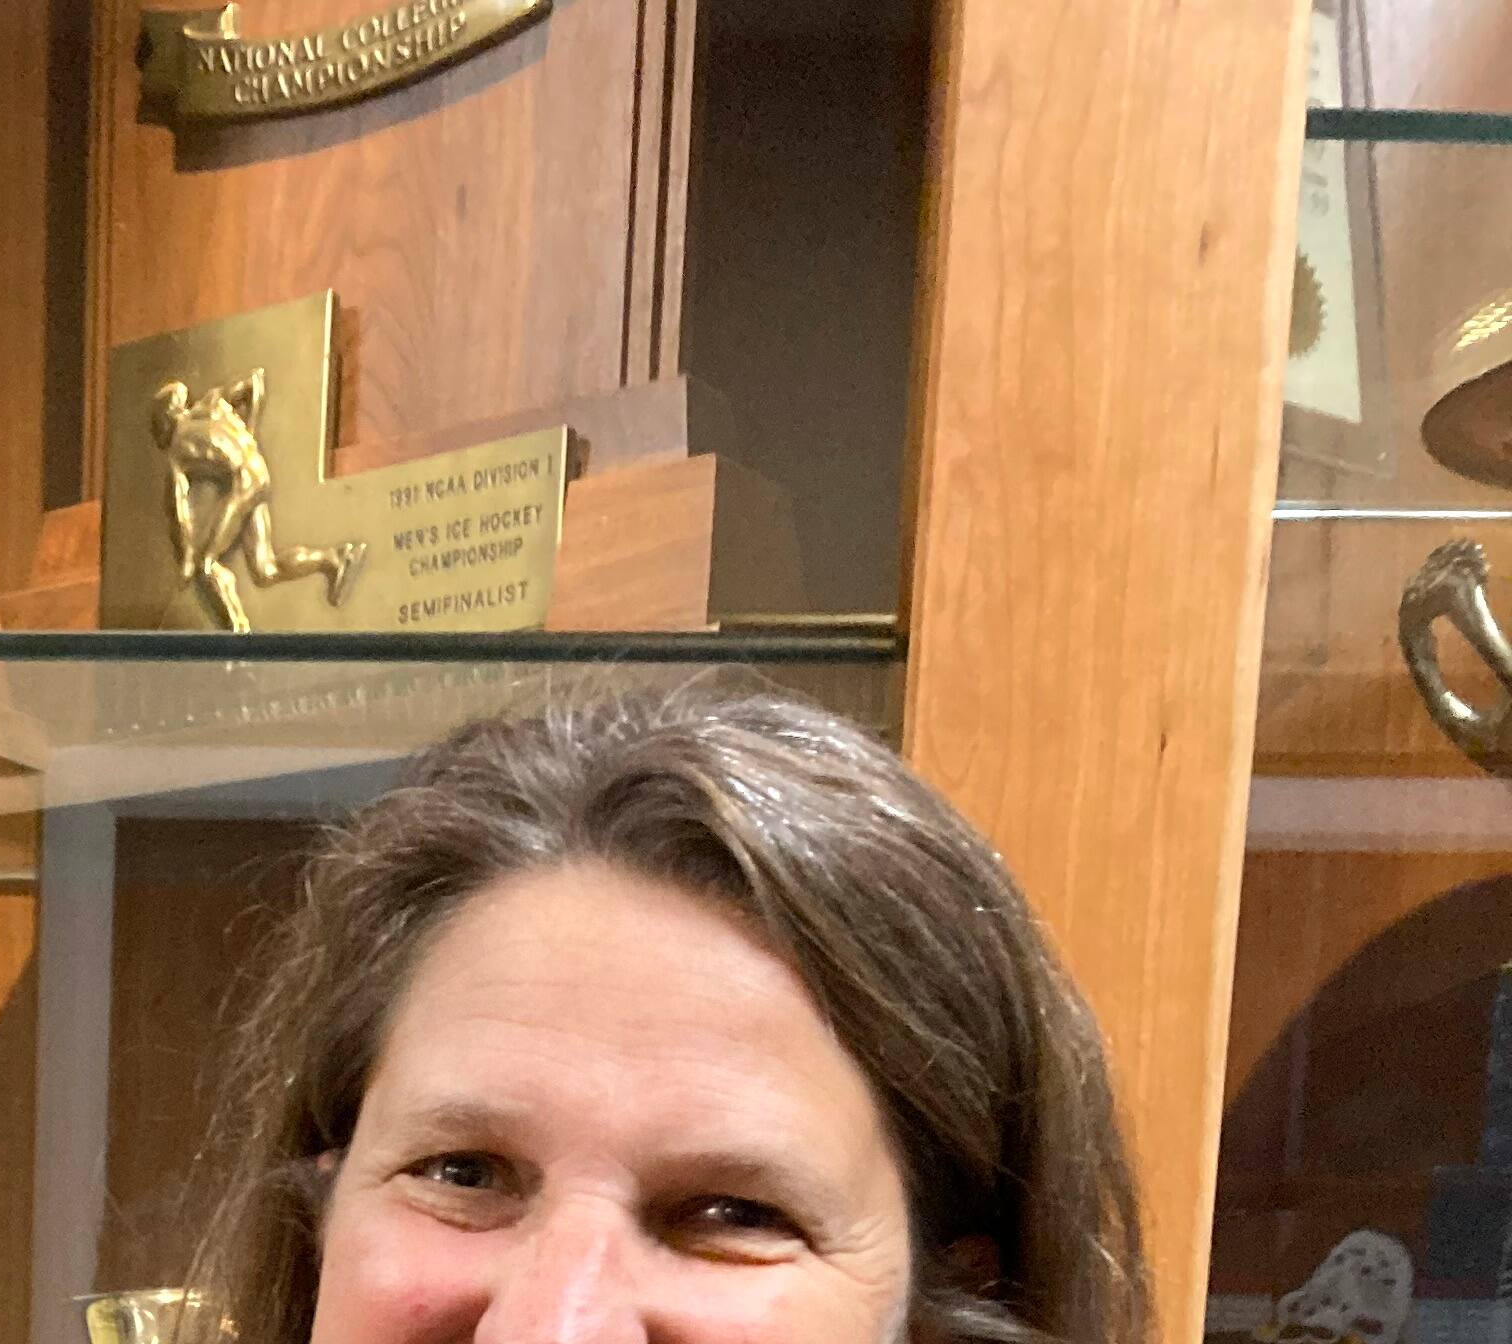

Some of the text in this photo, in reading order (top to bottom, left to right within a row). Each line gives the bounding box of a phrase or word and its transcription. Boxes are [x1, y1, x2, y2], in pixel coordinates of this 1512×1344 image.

[233, 9, 467, 104] CHAMPIONSHIP
[425, 473, 467, 501] NCAA
[472, 457, 540, 492] DIVISION
[445, 516, 472, 542] ICE
[479, 503, 543, 534] HOCKEY
[408, 536, 524, 577] CHAMPIONSHIP
[397, 580, 529, 624] SEMIFINALIST
